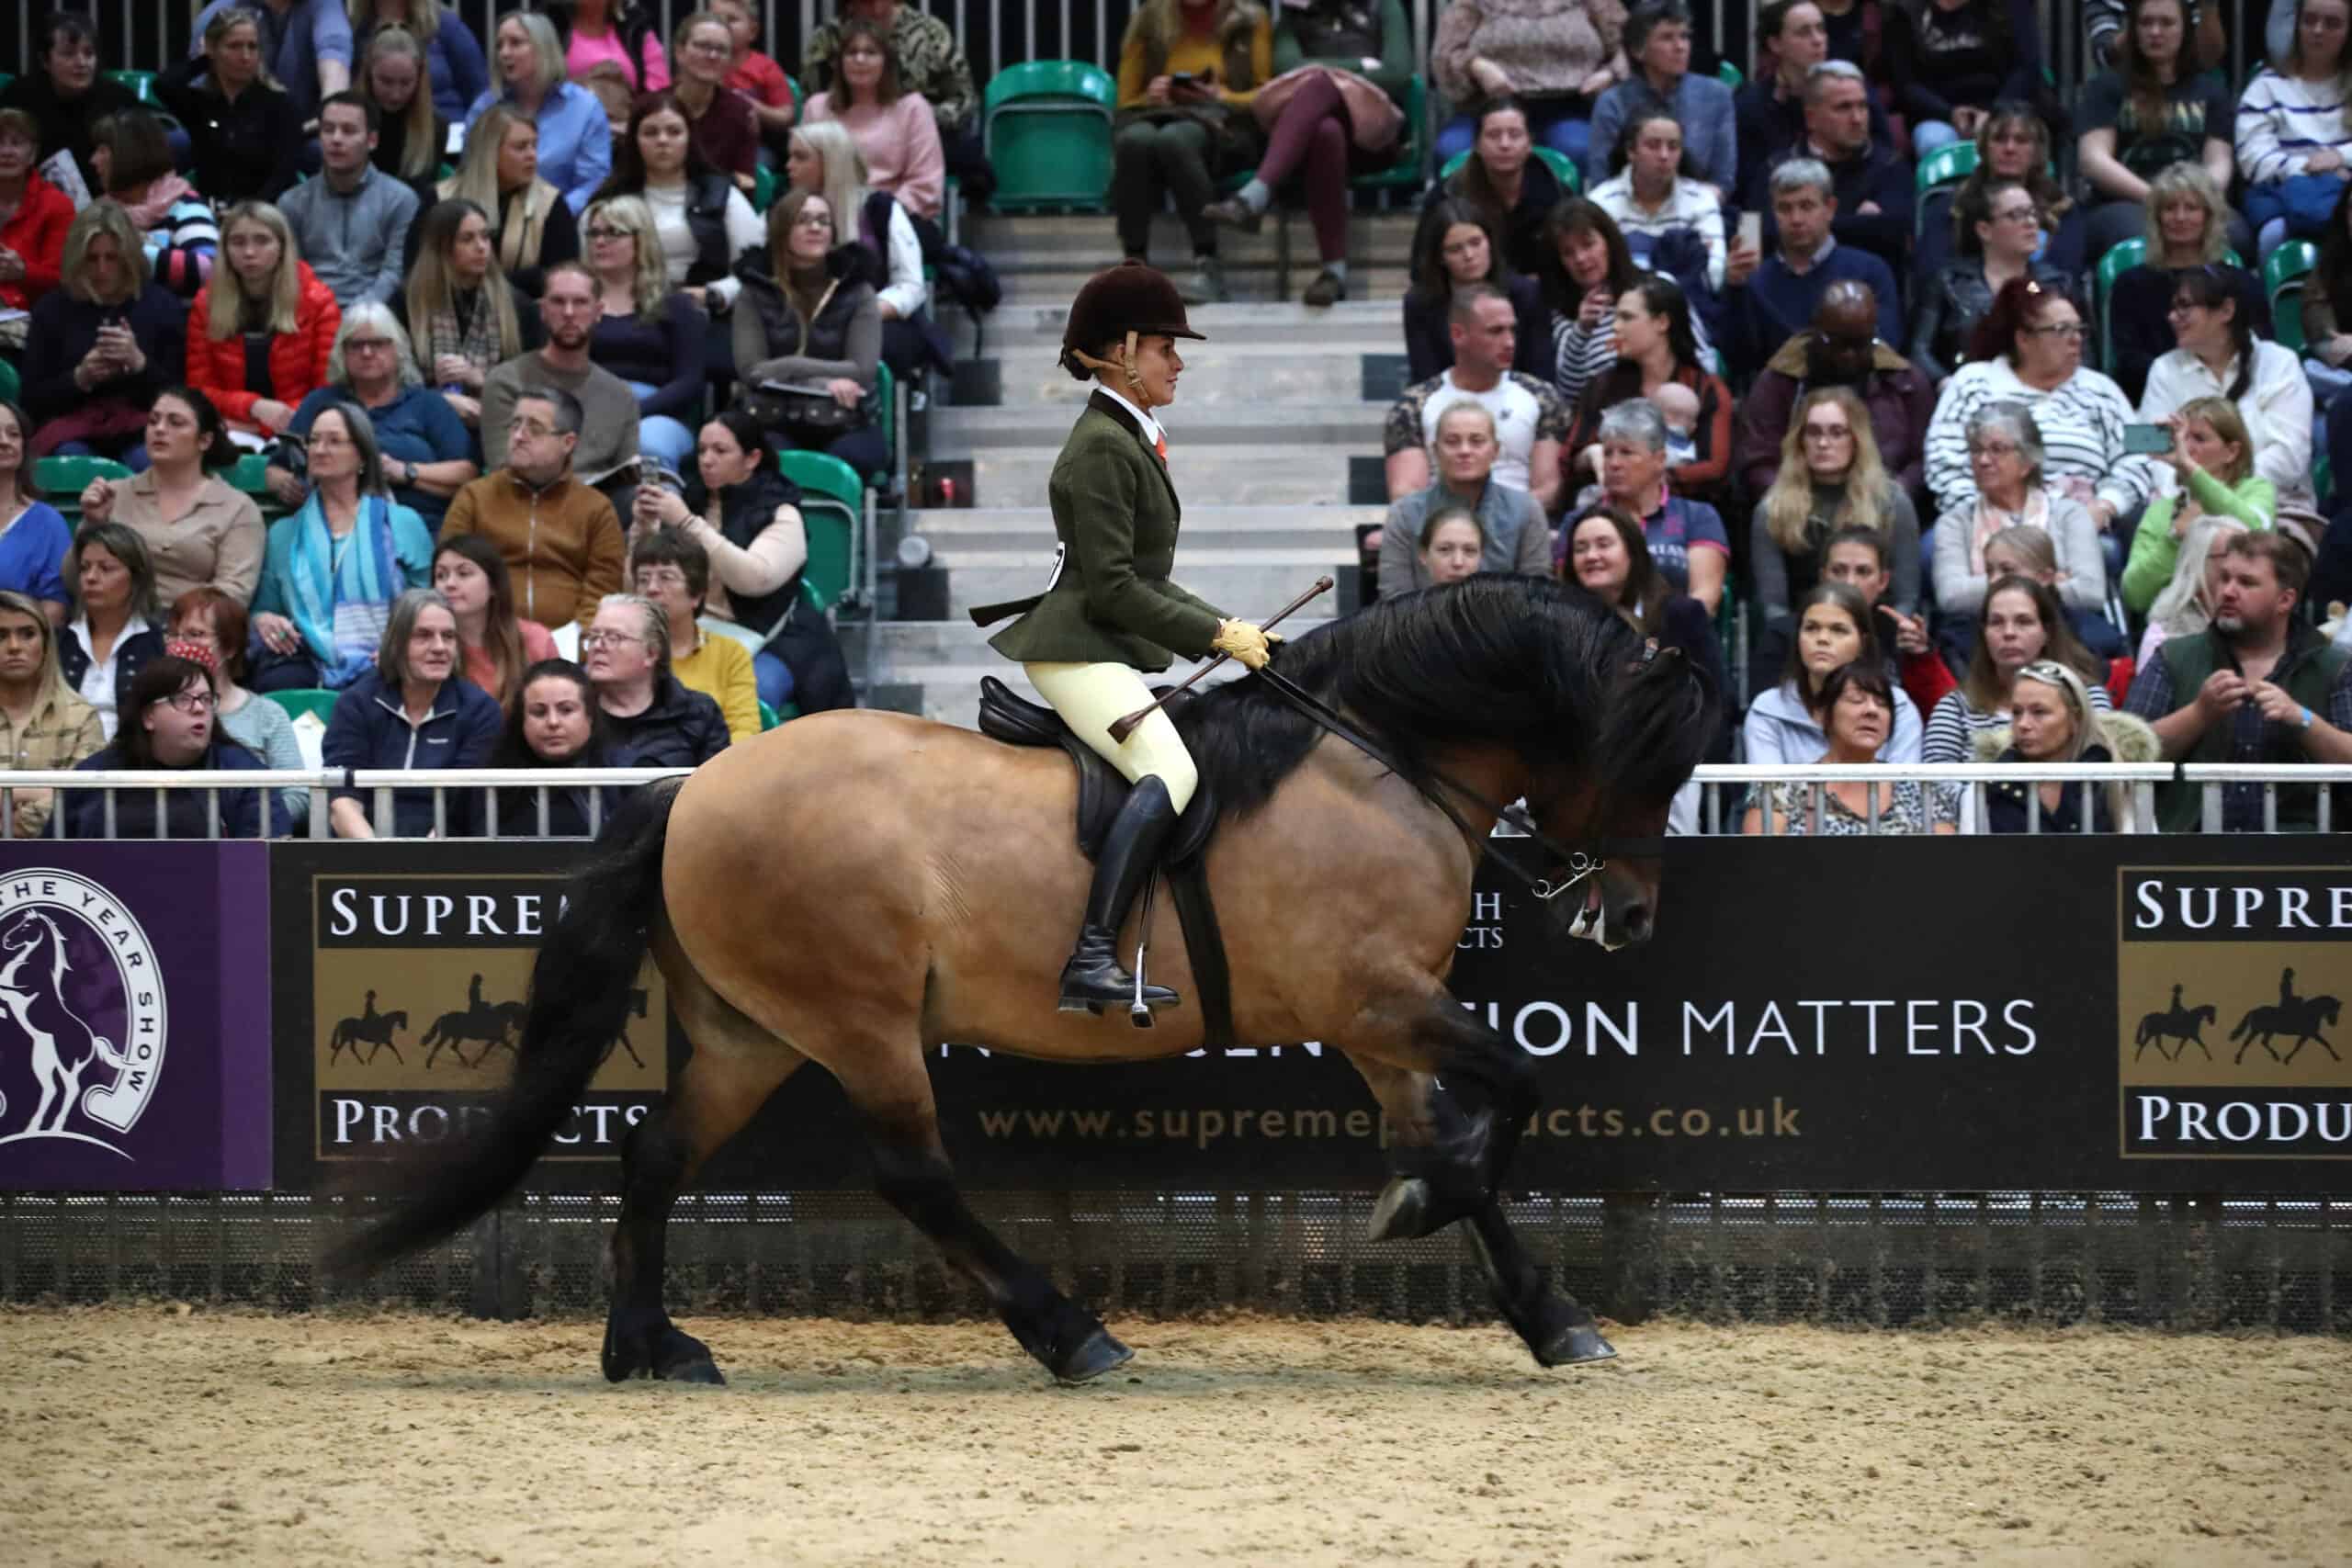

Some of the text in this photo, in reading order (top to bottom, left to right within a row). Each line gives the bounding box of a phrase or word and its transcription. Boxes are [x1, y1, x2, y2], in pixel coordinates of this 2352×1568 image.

[330, 887, 571, 935] SUPRE
[0, 880, 154, 1091] HE YEAR SHOW
[1682, 998, 2037, 1055] MATTERS
[332, 1099, 648, 1143] PROCTS
[978, 1097, 1801, 1149] www.supremects.co.uk
